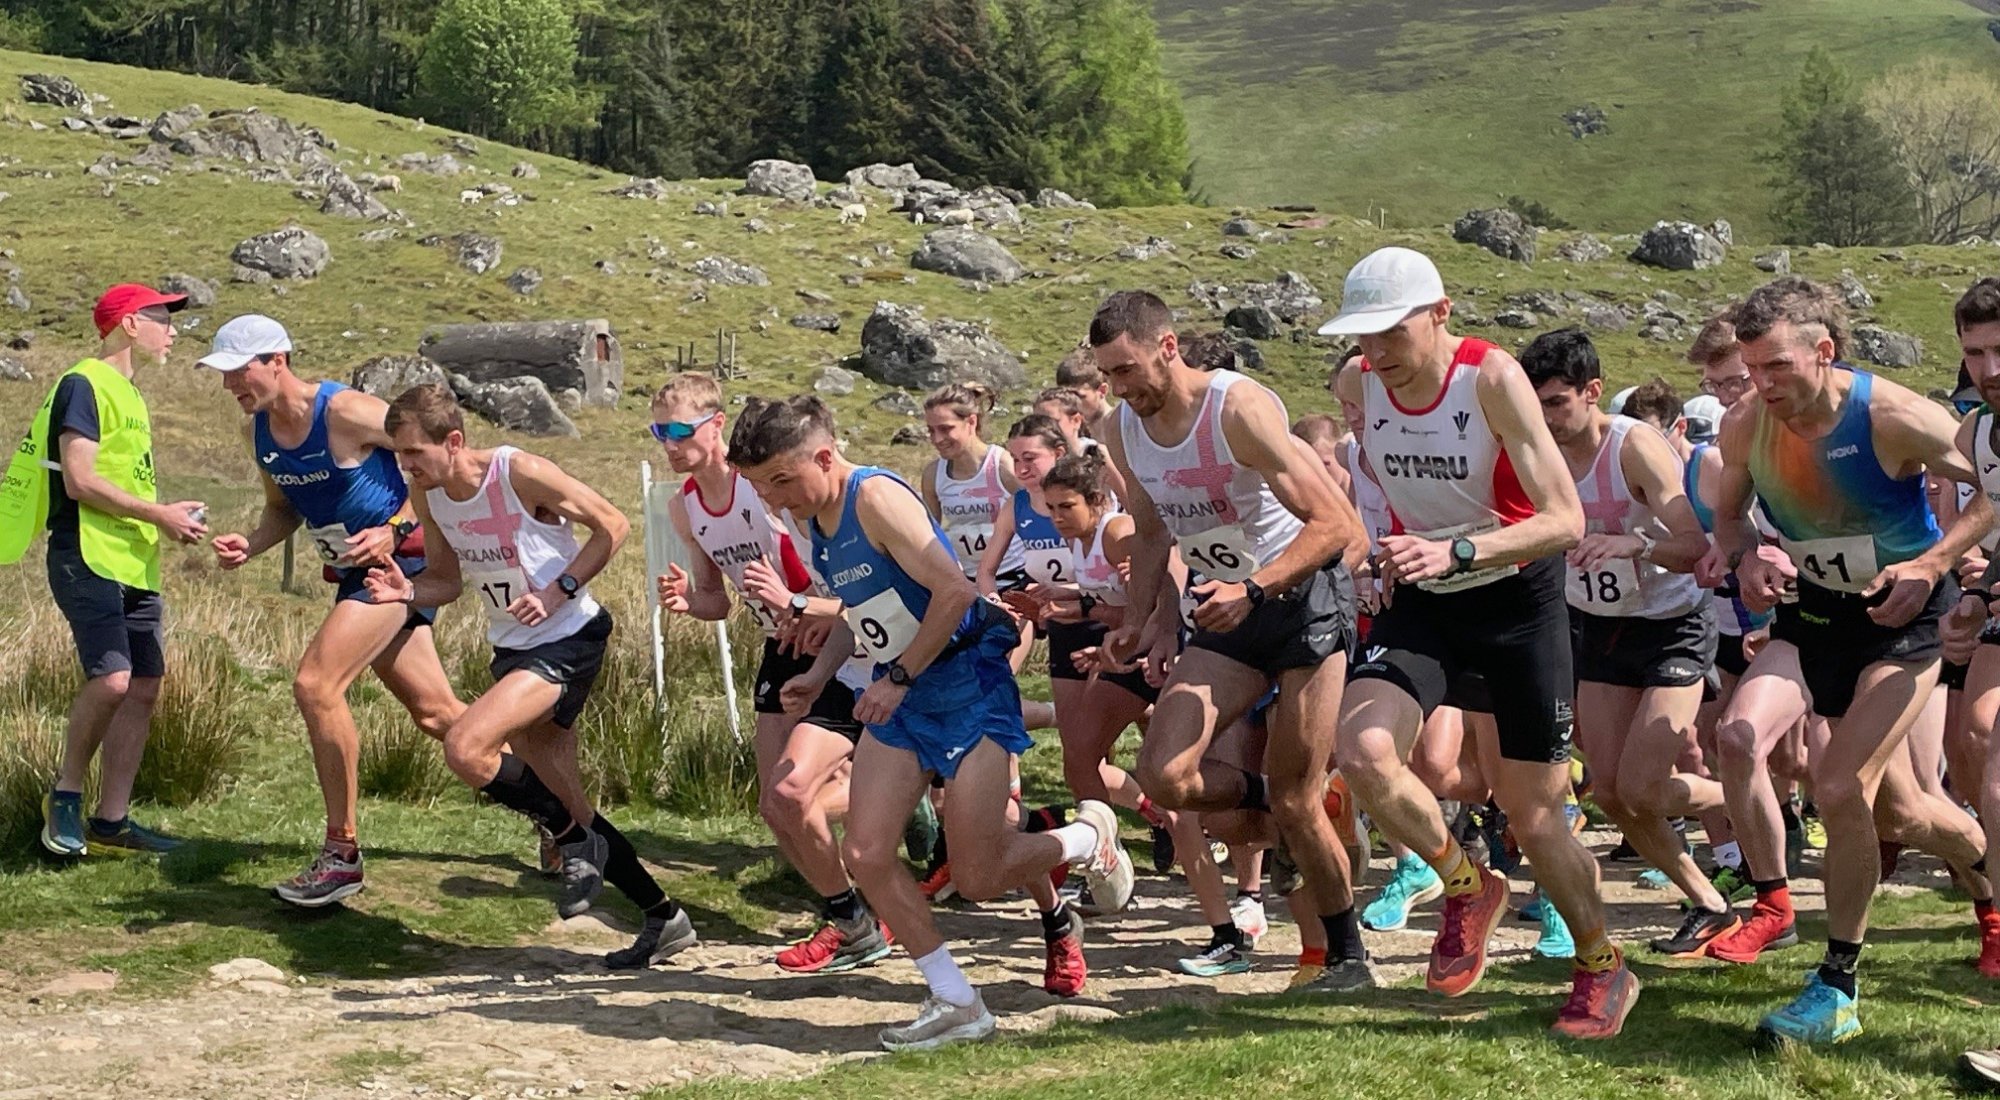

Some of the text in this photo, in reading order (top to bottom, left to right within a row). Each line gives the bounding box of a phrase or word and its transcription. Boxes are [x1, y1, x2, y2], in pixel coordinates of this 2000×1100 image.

[1346, 288, 1382, 305] OKA
[1827, 444, 1858, 460] HOKA
[1384, 453, 1469, 480] CYMRU
[712, 541, 763, 567] CYMRU
[959, 533, 987, 556] 14
[1189, 543, 1240, 569] 16
[1047, 558, 1068, 582] 2
[1804, 552, 1851, 583] 41
[481, 581, 511, 609] 17
[1579, 571, 1621, 603] 18
